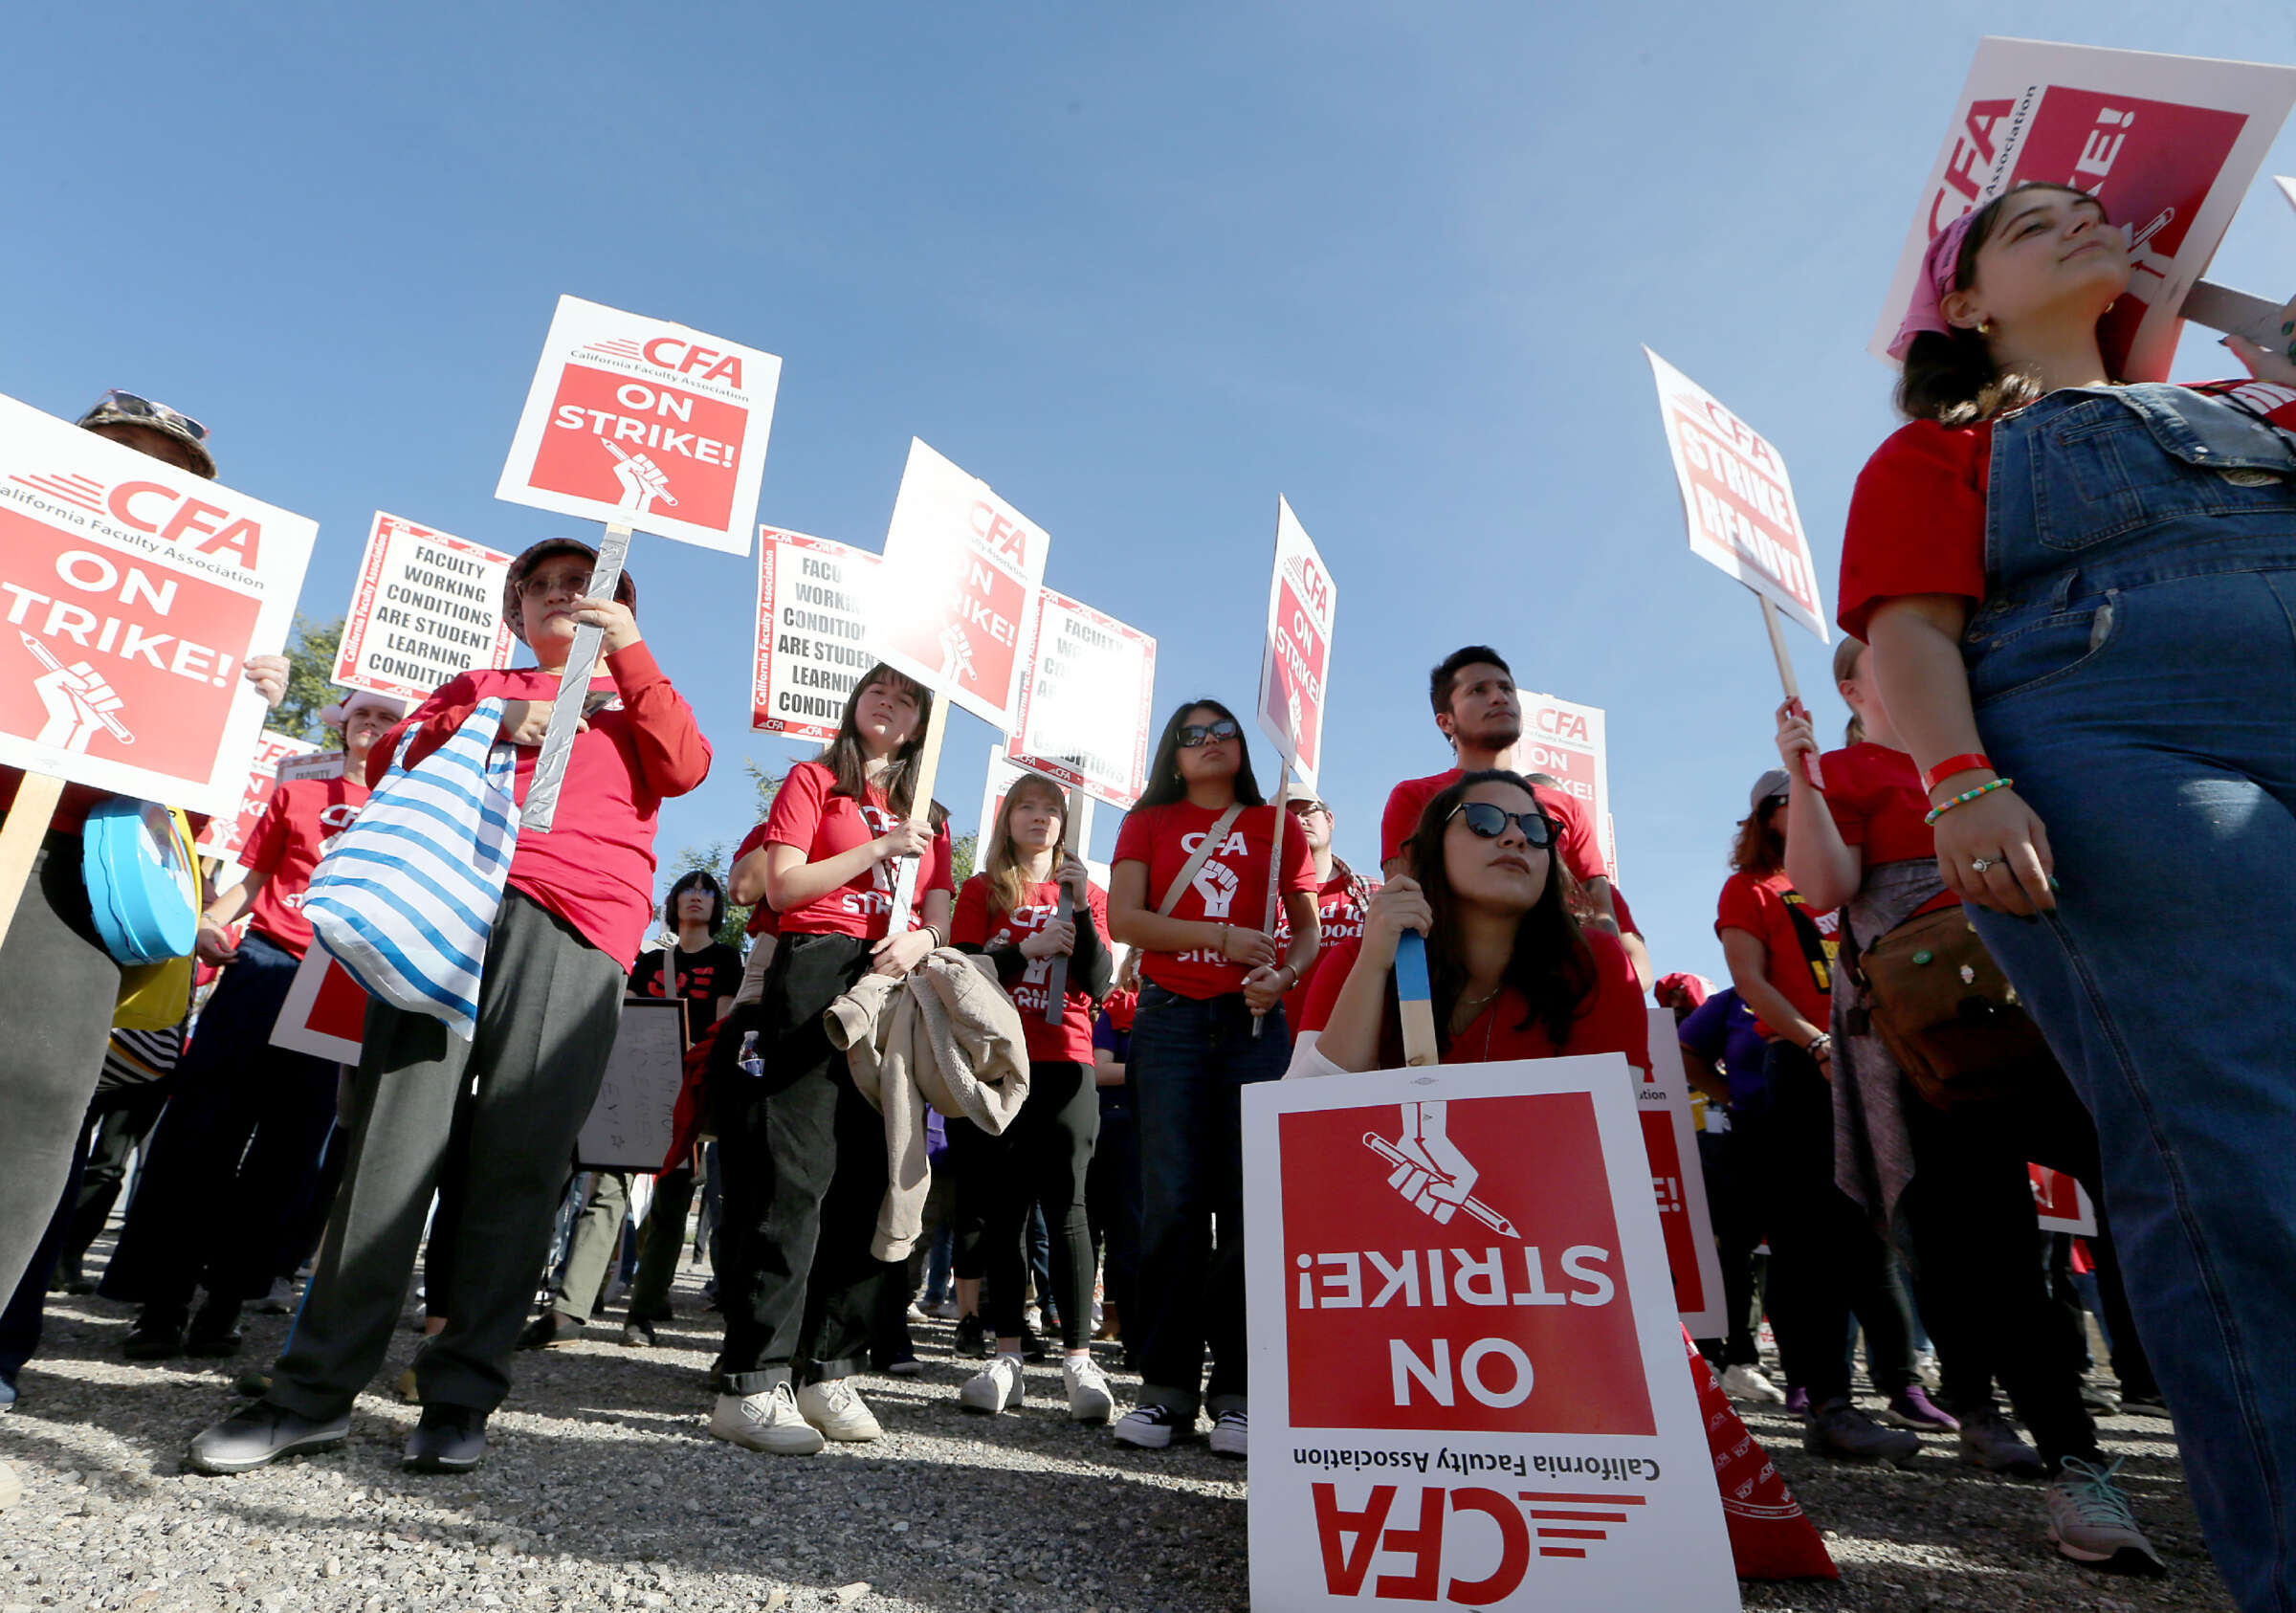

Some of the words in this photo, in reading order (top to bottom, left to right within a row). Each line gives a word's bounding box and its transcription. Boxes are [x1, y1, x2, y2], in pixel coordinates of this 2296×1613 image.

[1986, 85, 2037, 196] Association
[570, 350, 631, 369] California
[634, 363, 678, 383] Faculty
[680, 375, 749, 403] Association
[642, 337, 742, 390] CFA
[616, 383, 694, 422] ON
[554, 405, 735, 469] STRIKE!
[1706, 401, 1777, 474] CFA
[1680, 420, 1794, 536] STRIKE
[0, 482, 85, 526] alifornia
[91, 519, 160, 553] Faculty
[164, 547, 264, 589] Association
[108, 480, 261, 571] CFA
[970, 499, 1027, 567] CFA
[1695, 482, 1810, 604] READY!
[55, 549, 179, 617] ON
[404, 564, 486, 603] WORKING
[415, 545, 486, 580] FACULTY
[762, 549, 774, 609] Association
[344, 618, 365, 662] California
[357, 585, 378, 618] Faculty
[368, 534, 388, 586] Association
[386, 584, 493, 628] CONDITIONS
[1302, 557, 1328, 622] CFA
[1, 581, 233, 688] TRIKE!
[377, 606, 411, 628] ARE
[414, 617, 491, 651] STUDENT
[759, 610, 774, 650] Faculty
[778, 634, 809, 657] ARE
[784, 608, 866, 642] CONDITIO
[1293, 609, 1314, 657] ON
[386, 633, 471, 669] LEARNING
[1275, 626, 1320, 706] STRIKE!
[756, 652, 770, 706] California
[792, 665, 859, 694] LEARNIN
[765, 719, 784, 731] CFA
[806, 725, 823, 737] CFA
[1536, 708, 1588, 742] CFA
[1020, 754, 1036, 766] CFA
[1056, 768, 1071, 781] CFA
[1531, 746, 1569, 772] ON
[320, 804, 363, 829] CF
[858, 805, 899, 832] CF
[1296, 1245, 1616, 1310] STRIKE!
[1389, 1337, 1534, 1409] ON
[1292, 1447, 1429, 1474] Association
[1437, 1449, 1528, 1477] Faculty
[1533, 1455, 1661, 1482] California
[1311, 1482, 1531, 1606] CFA
